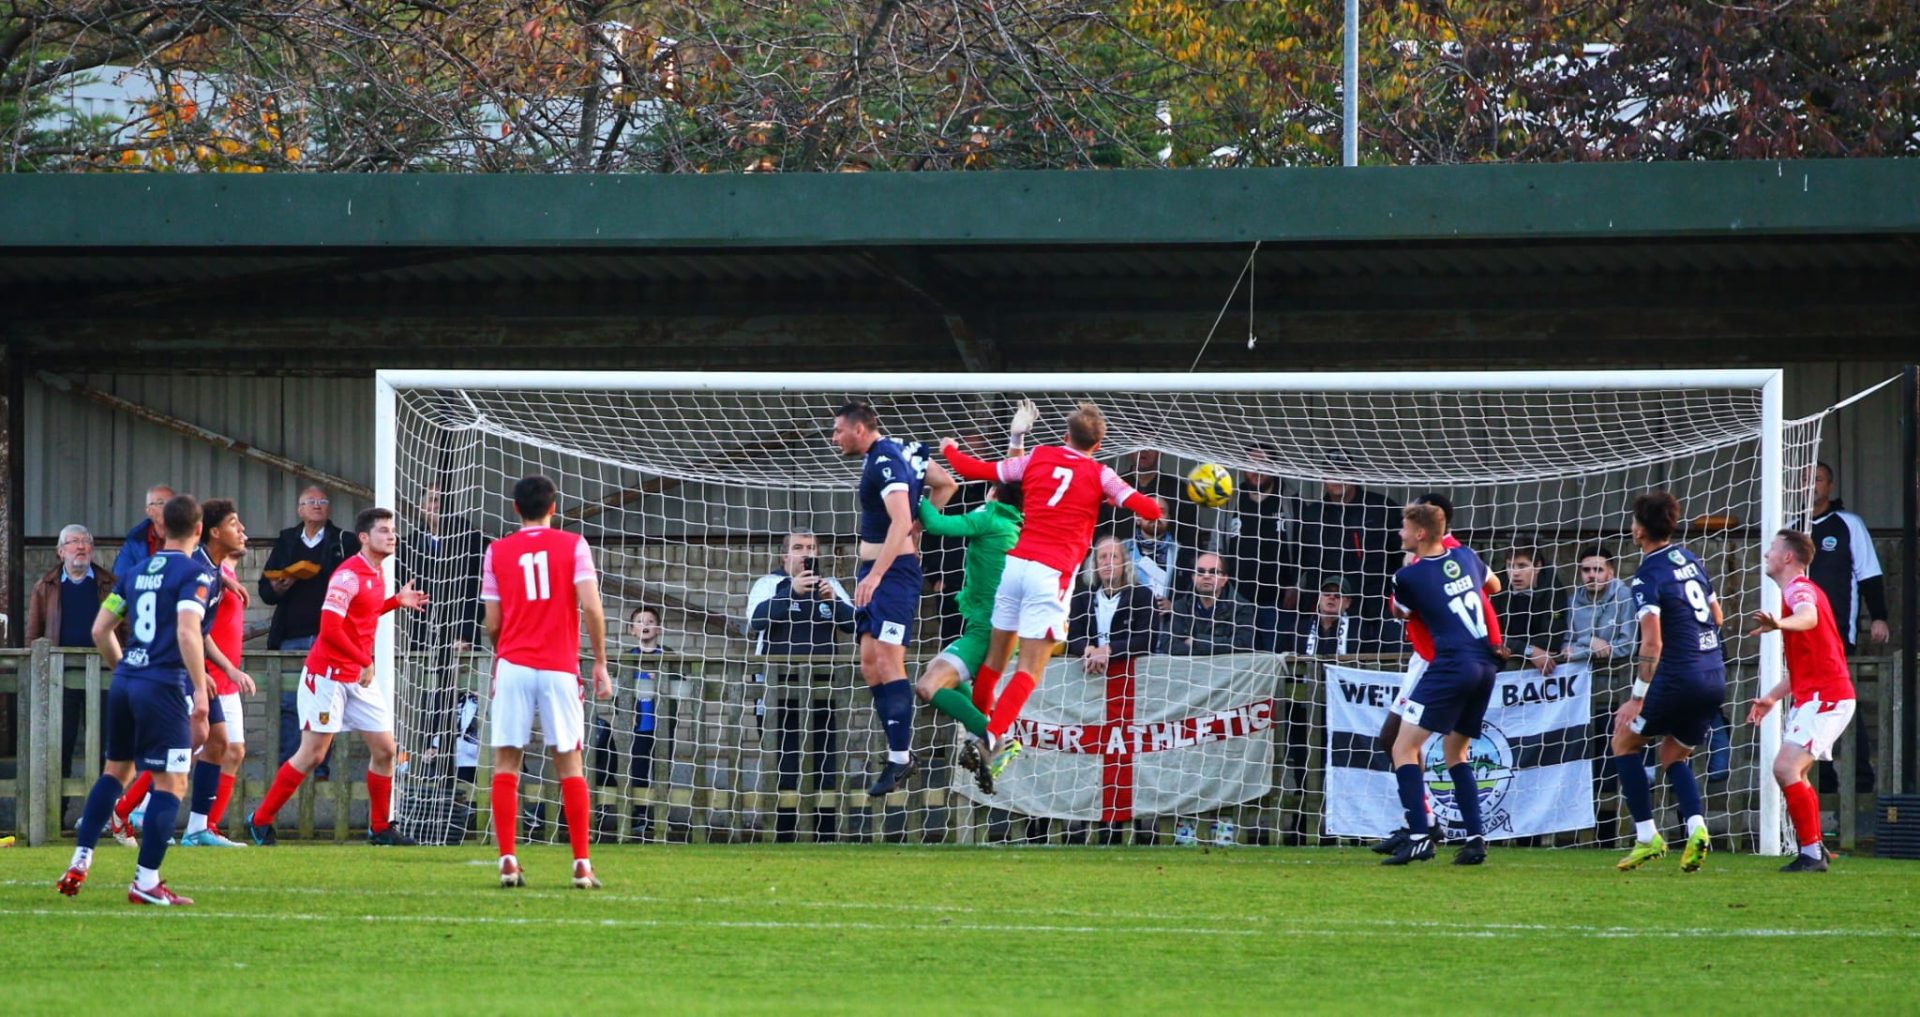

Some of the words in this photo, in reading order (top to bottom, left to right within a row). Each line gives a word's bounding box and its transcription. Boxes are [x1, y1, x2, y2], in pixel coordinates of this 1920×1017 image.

[1047, 466, 1073, 506] 7
[518, 550, 550, 600] 11
[134, 591, 156, 643] 8
[1448, 591, 1488, 639] 12
[1684, 579, 1710, 622] 9
[1502, 675, 1578, 707] BACK
[1106, 703, 1271, 754] ATHLETIC
